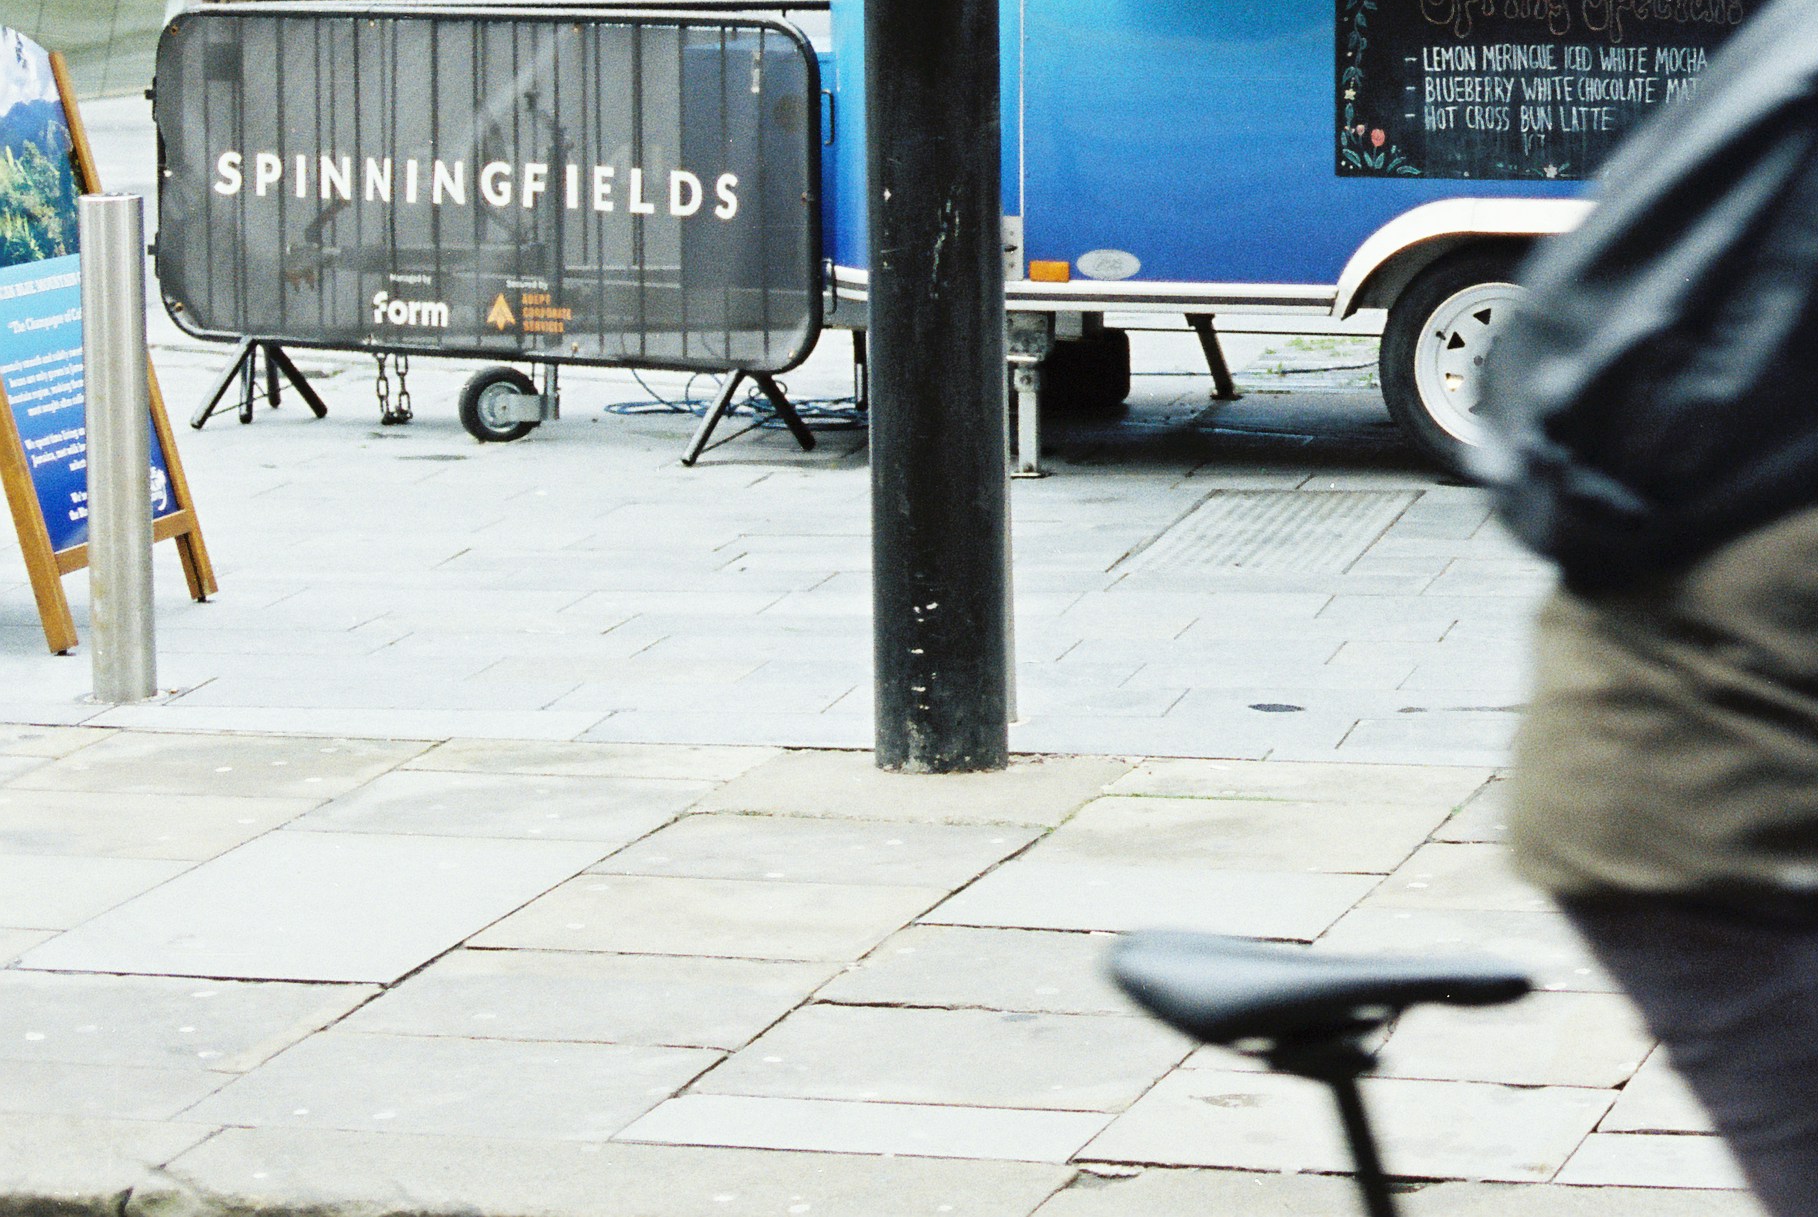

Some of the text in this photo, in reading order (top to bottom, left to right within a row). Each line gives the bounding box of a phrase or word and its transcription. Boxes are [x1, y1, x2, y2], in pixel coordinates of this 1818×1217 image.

[1424, 44, 1708, 73] LEMON MERINGUE ICED WHITE MOCHA
[1425, 77, 1514, 103] BLUEBERRY
[1521, 76, 1574, 102] WHITE
[1578, 77, 1659, 103] CHOCOLATE
[1424, 105, 1616, 133] HOT CROSS BUN LATTE
[214, 151, 738, 220] SPINNINGFIELDS
[373, 290, 448, 327] form
